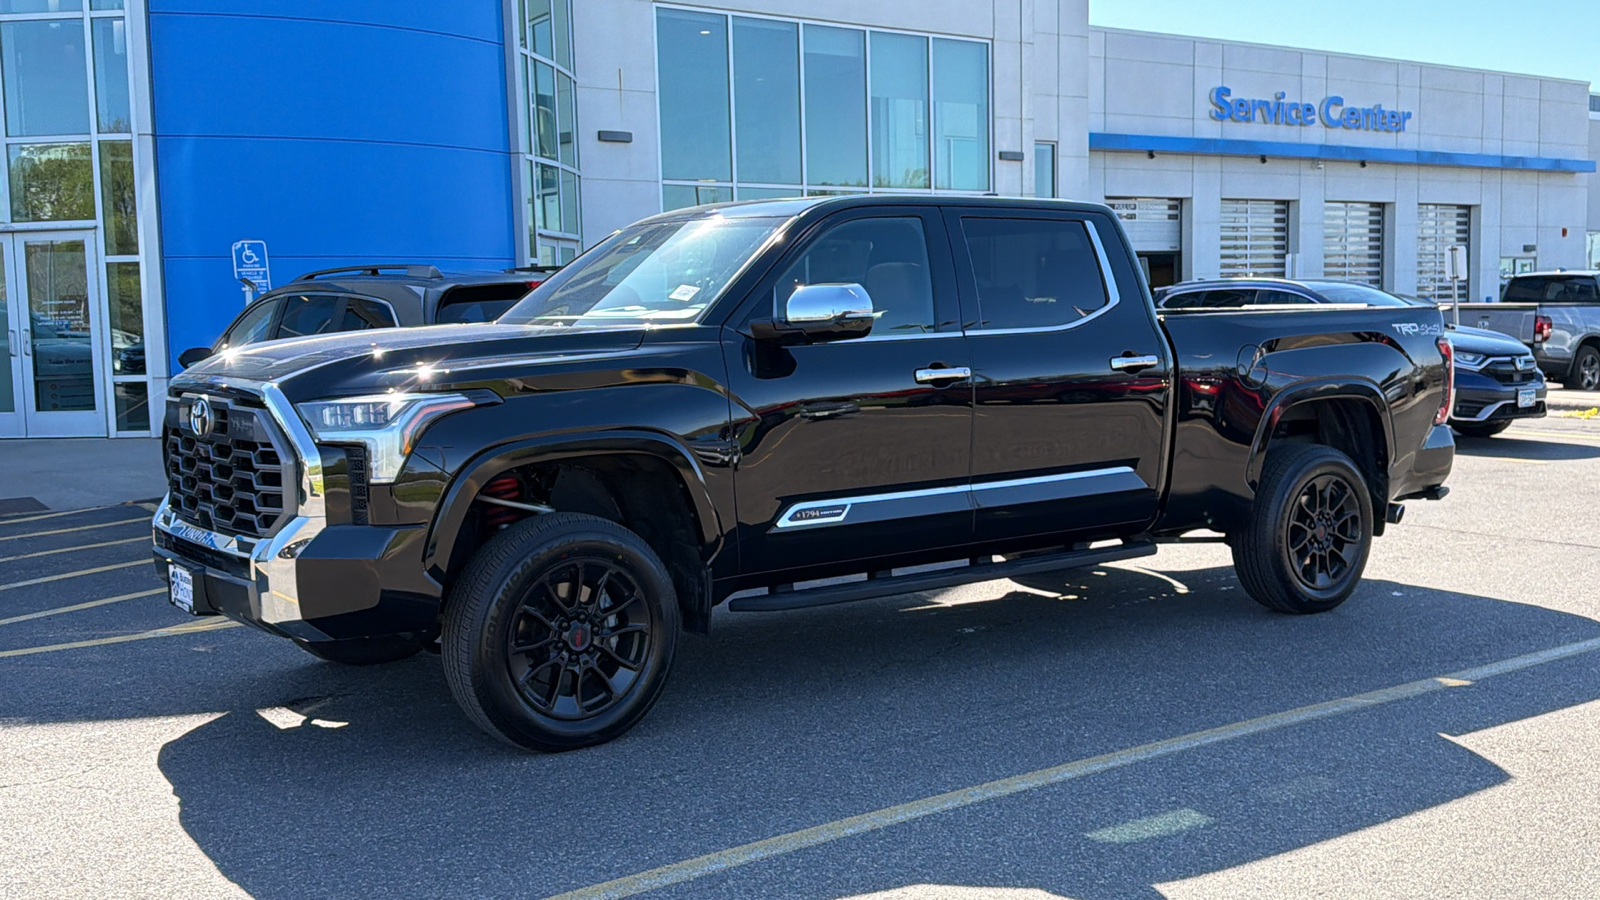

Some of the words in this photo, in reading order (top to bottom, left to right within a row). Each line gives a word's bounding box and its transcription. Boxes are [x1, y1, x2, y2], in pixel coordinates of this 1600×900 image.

[1210, 86, 1316, 126] Service
[1320, 95, 1412, 133] Center
[1391, 322, 1419, 337] TRD
[802, 510, 819, 519] 1794
